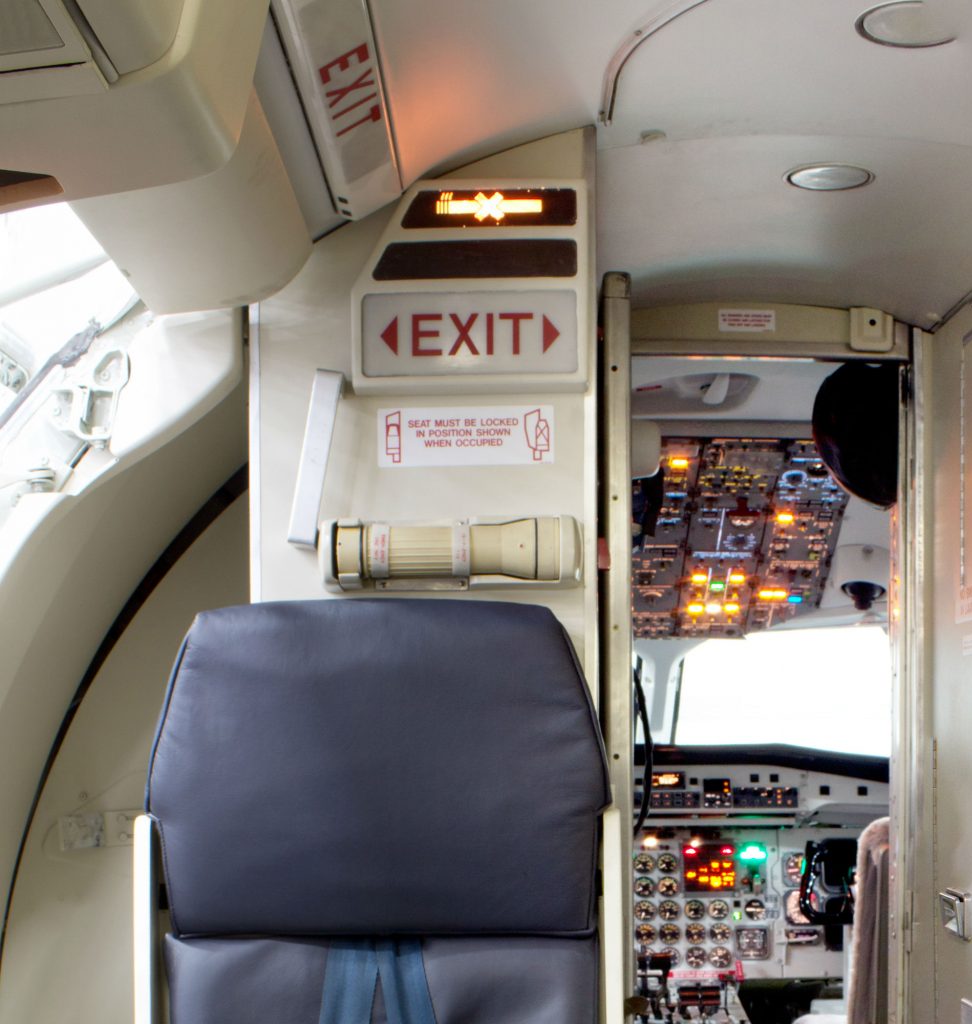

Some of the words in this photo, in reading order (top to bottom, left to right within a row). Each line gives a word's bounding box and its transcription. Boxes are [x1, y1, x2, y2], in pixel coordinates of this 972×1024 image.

[319, 42, 381, 137] EXIT
[412, 313, 533, 357] EXIT
[408, 419, 432, 429] SEAT
[434, 419, 460, 428] MUST
[464, 418, 476, 427] BE
[480, 418, 519, 427] LOCKED
[416, 430, 425, 438] IN
[429, 429, 473, 438] POSITION
[476, 428, 511, 437] SHOWN
[424, 439, 452, 448] WHEN
[455, 438, 503, 447] OCCUPIED
